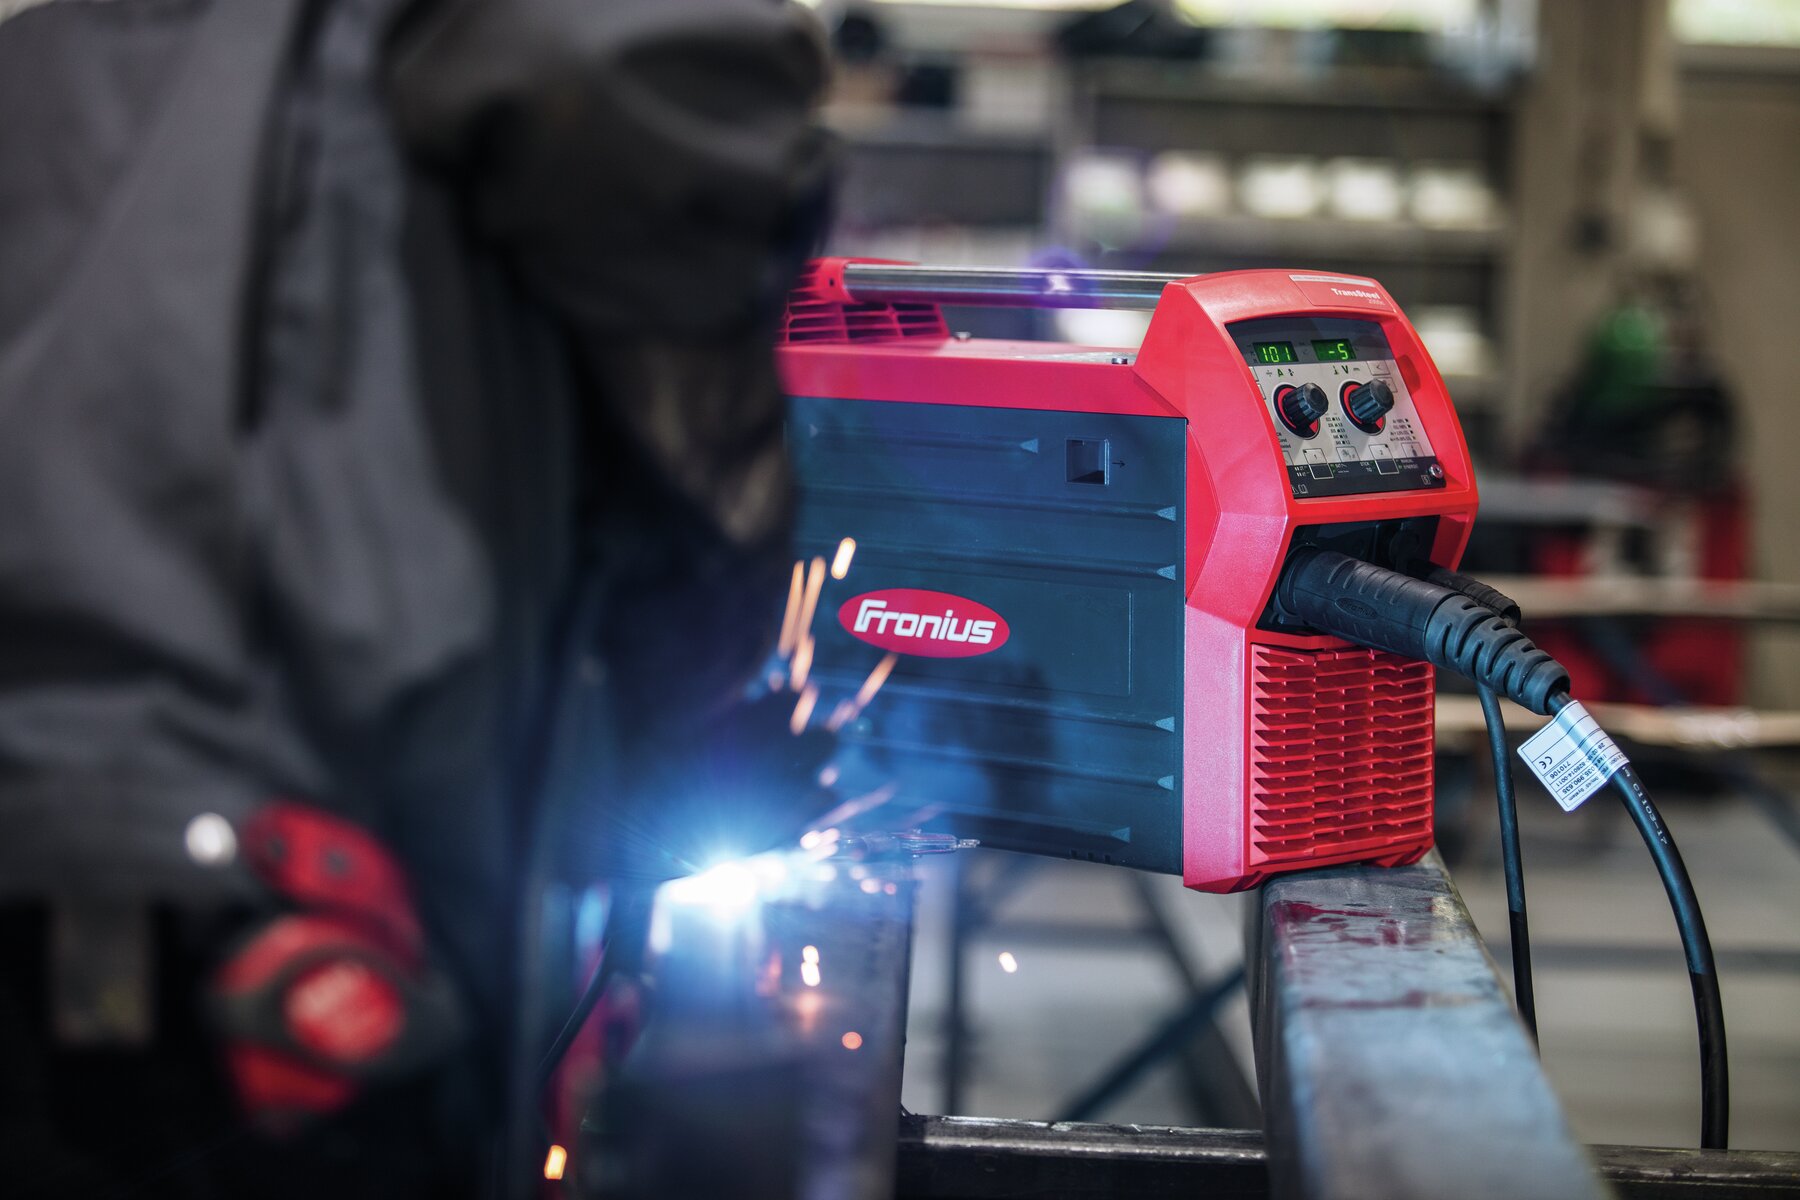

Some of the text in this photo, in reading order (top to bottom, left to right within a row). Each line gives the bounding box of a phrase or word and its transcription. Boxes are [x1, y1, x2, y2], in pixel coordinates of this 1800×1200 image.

[1331, 288, 1380, 299] TransSteel
[1262, 346, 1291, 362] 101
[854, 599, 996, 644] Fronius
[1550, 761, 1571, 779] 710106
